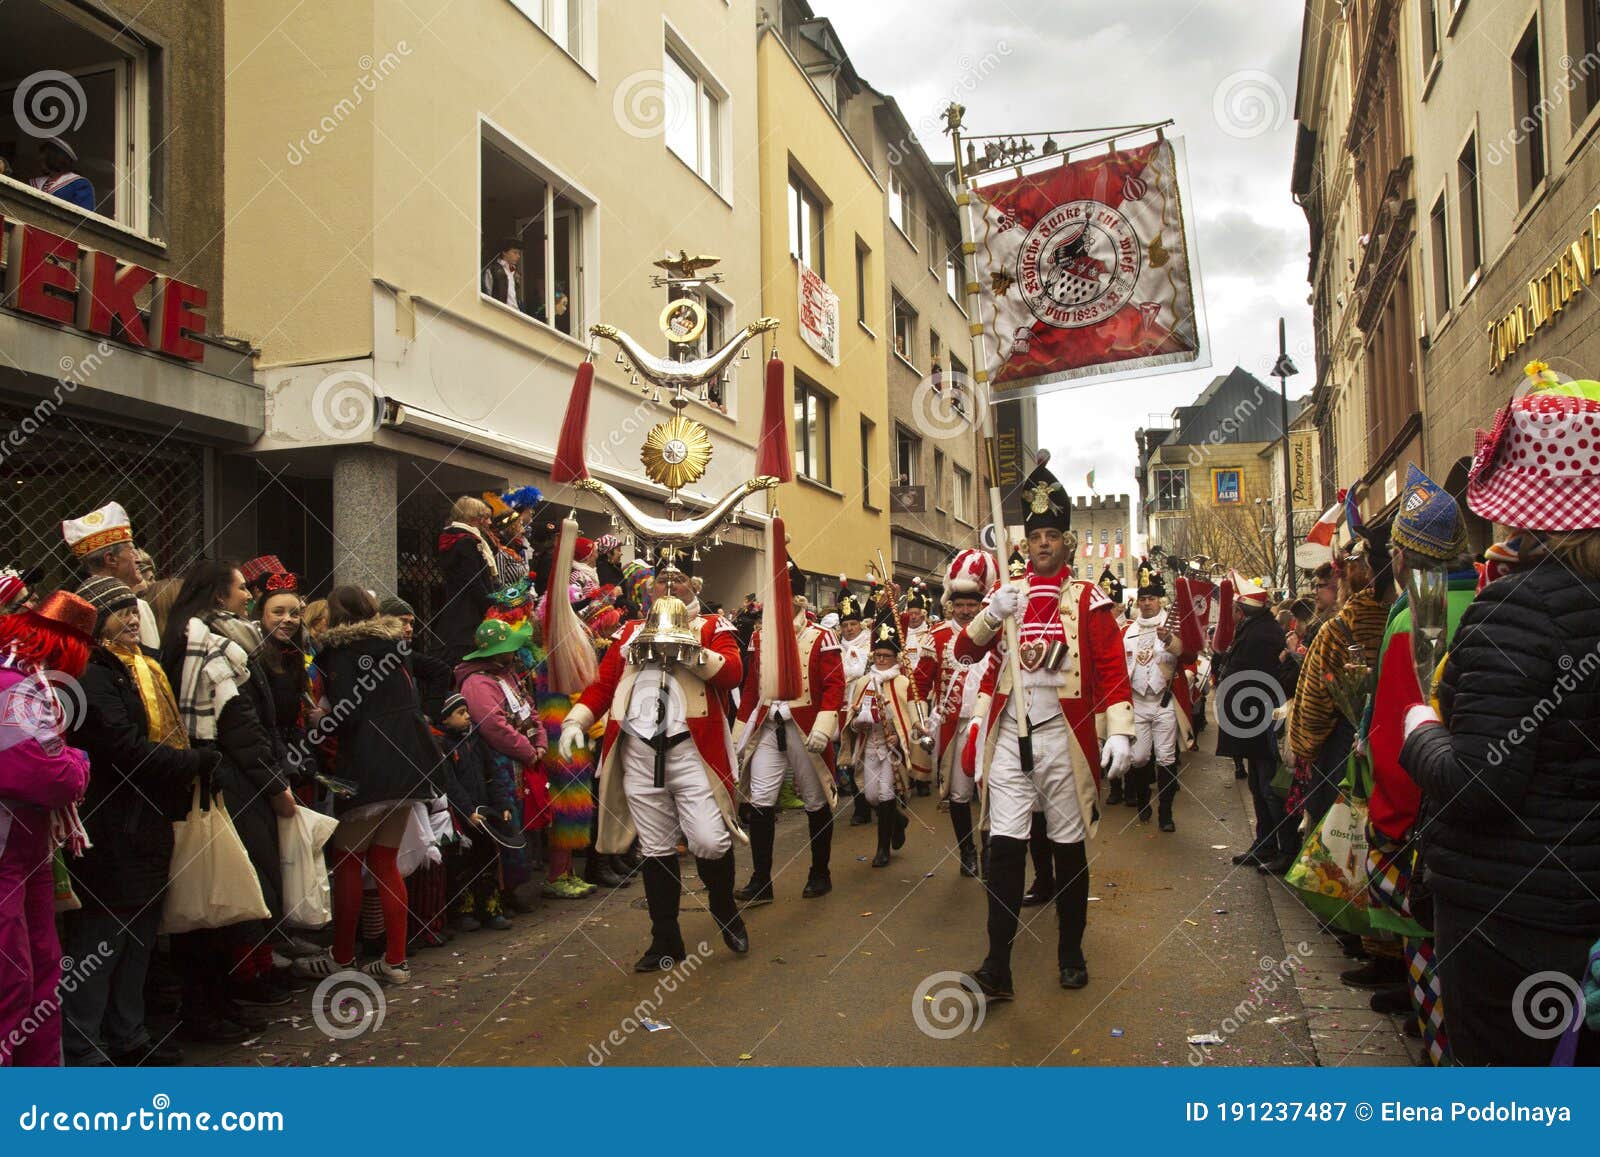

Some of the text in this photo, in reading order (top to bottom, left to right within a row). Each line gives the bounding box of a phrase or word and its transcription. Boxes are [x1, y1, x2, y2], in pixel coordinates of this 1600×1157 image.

[0, 214, 208, 363] EKE
[1073, 306, 1098, 321] 1823
[1218, 490, 1239, 500] ALDI
